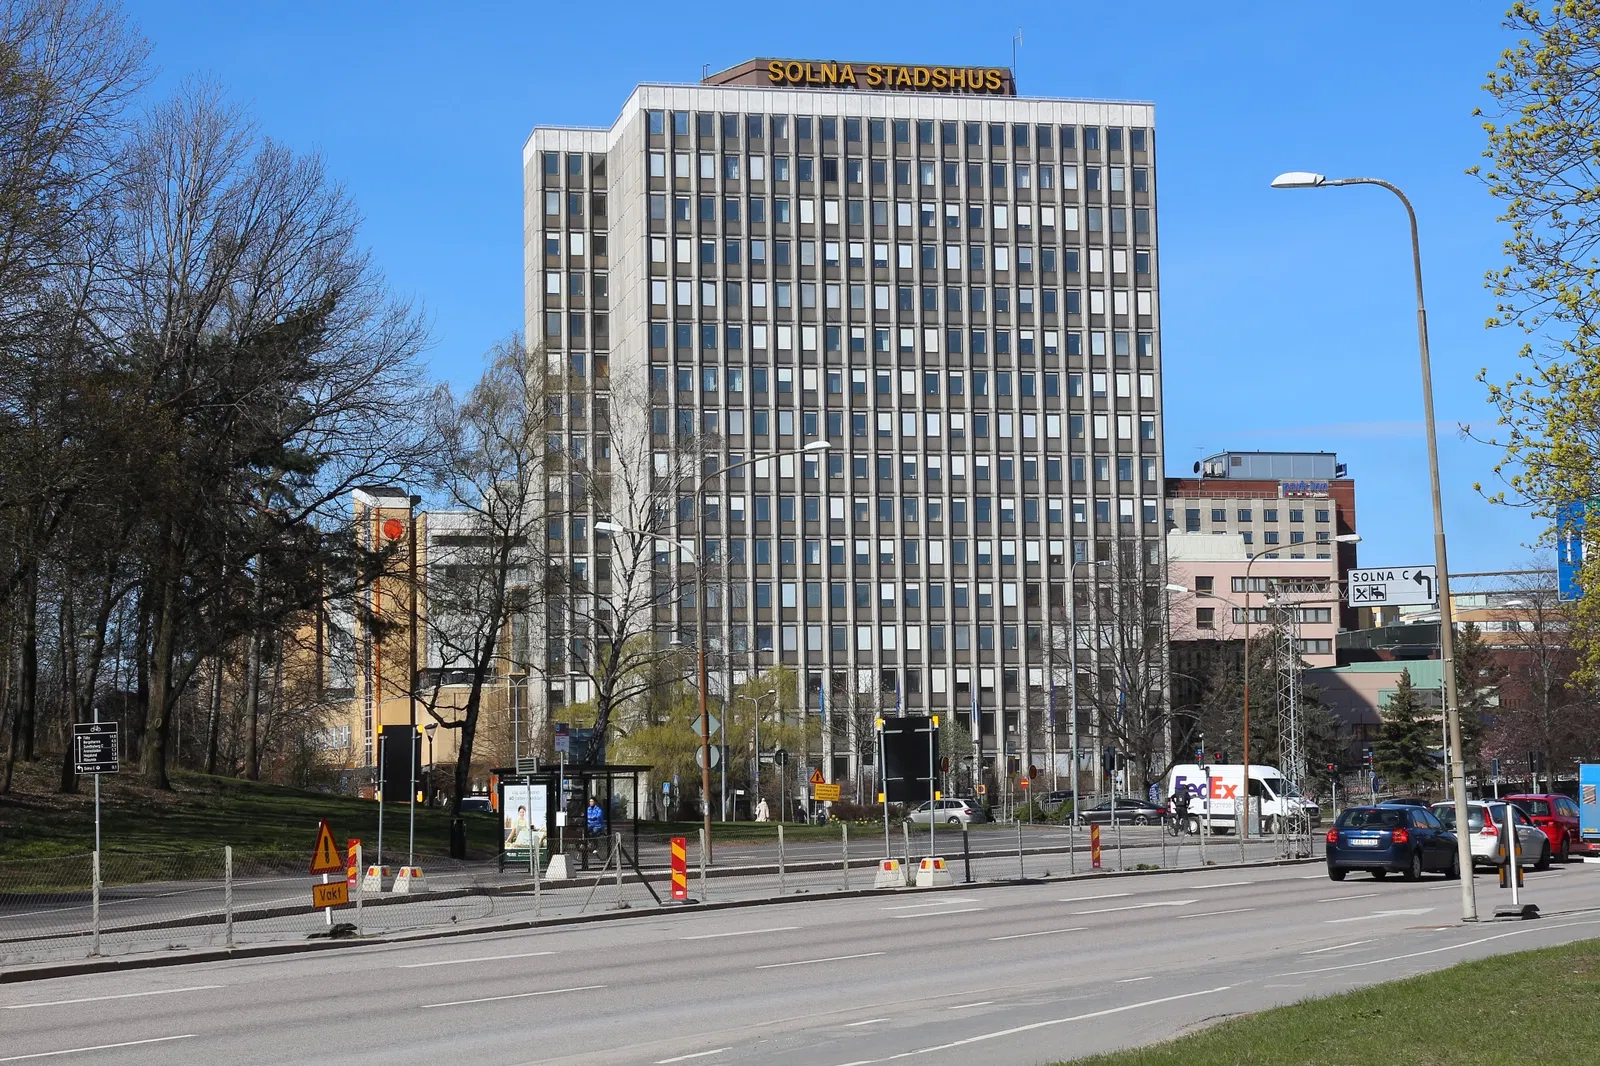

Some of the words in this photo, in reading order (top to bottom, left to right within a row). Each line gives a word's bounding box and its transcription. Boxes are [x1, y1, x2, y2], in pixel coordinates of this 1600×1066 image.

[768, 61, 856, 83] SOLNA
[866, 65, 1001, 90] STADSHUS
[1352, 571, 1395, 583] SOLNA
[1402, 570, 1410, 580] C
[1175, 776, 1238, 799] FedEx
[319, 887, 342, 901] Vakt
